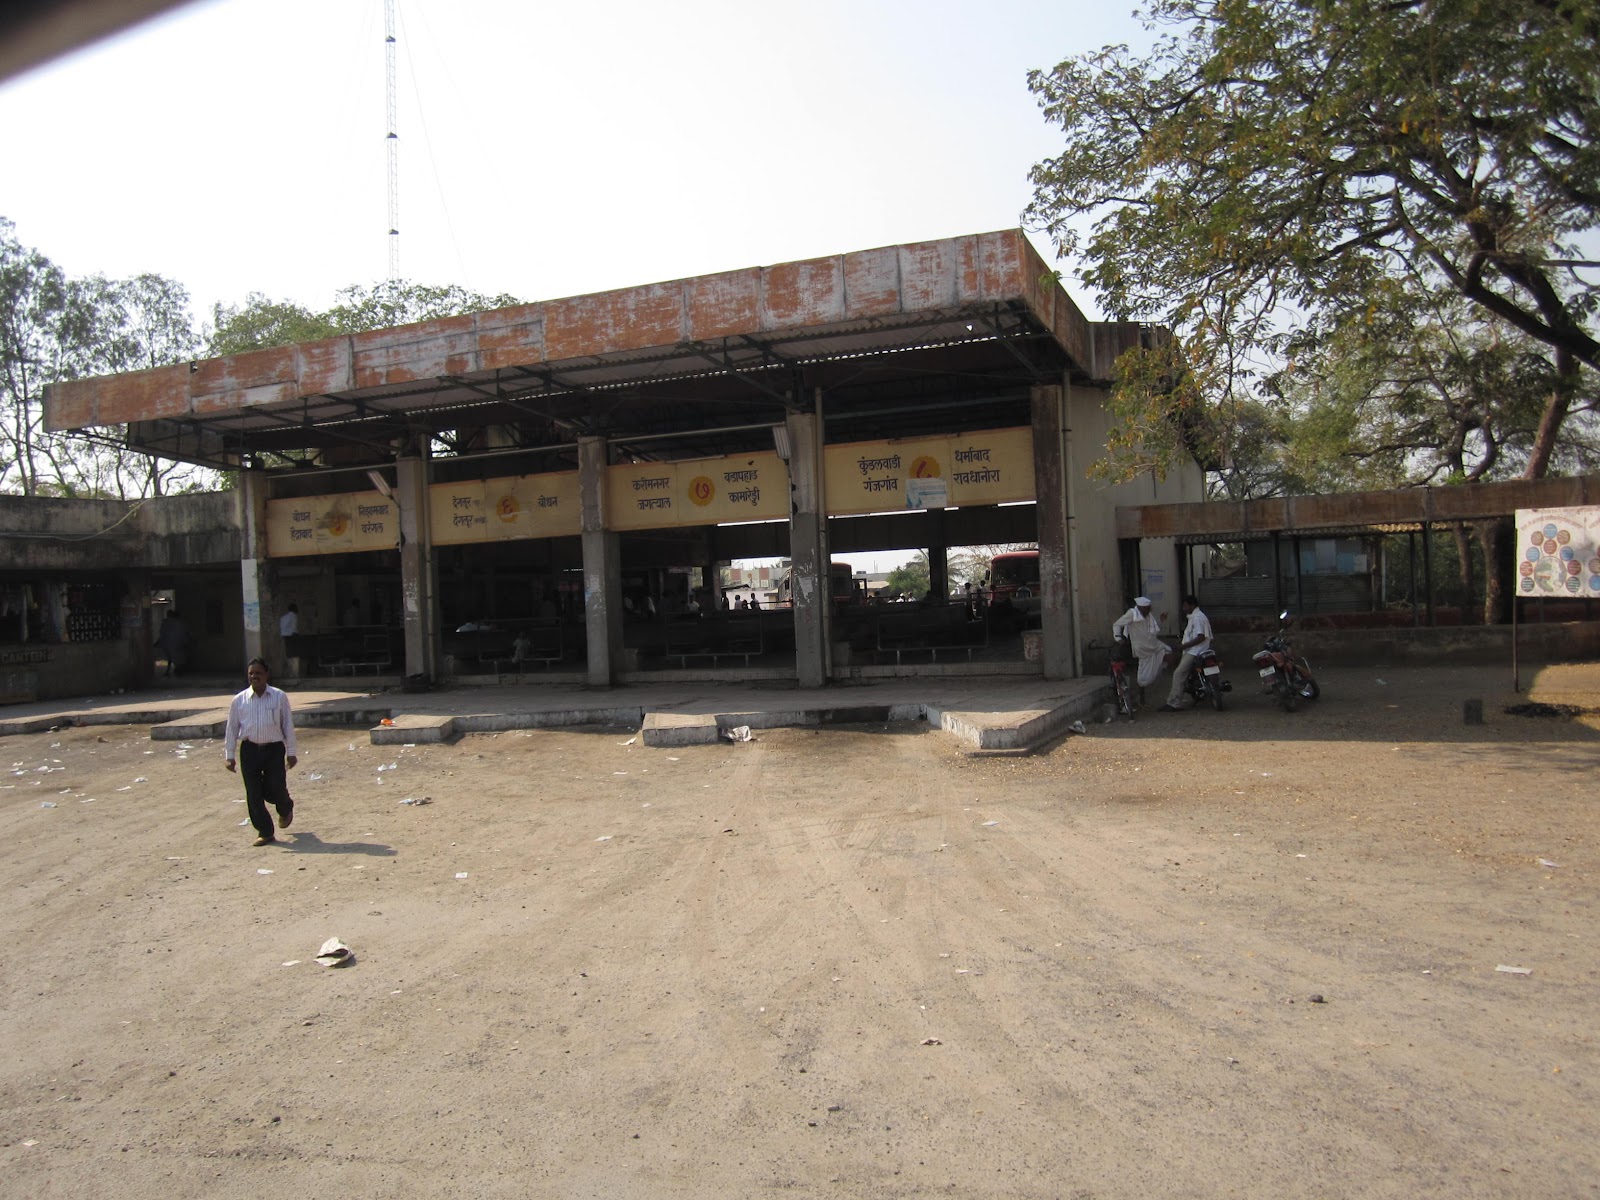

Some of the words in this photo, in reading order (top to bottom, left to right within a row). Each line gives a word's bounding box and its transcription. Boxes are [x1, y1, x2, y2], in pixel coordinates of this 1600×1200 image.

[955, 447, 991, 463] धर्माबाद
[857, 454, 901, 475] कुंडलवाडी
[632, 477, 670, 491] करीमनगर
[695, 481, 709, 499] ७
[863, 475, 898, 492] गंजगांव
[537, 494, 558, 508] बोधन
[637, 497, 671, 511] जगत्याल
[292, 510, 311, 522] बोधन
